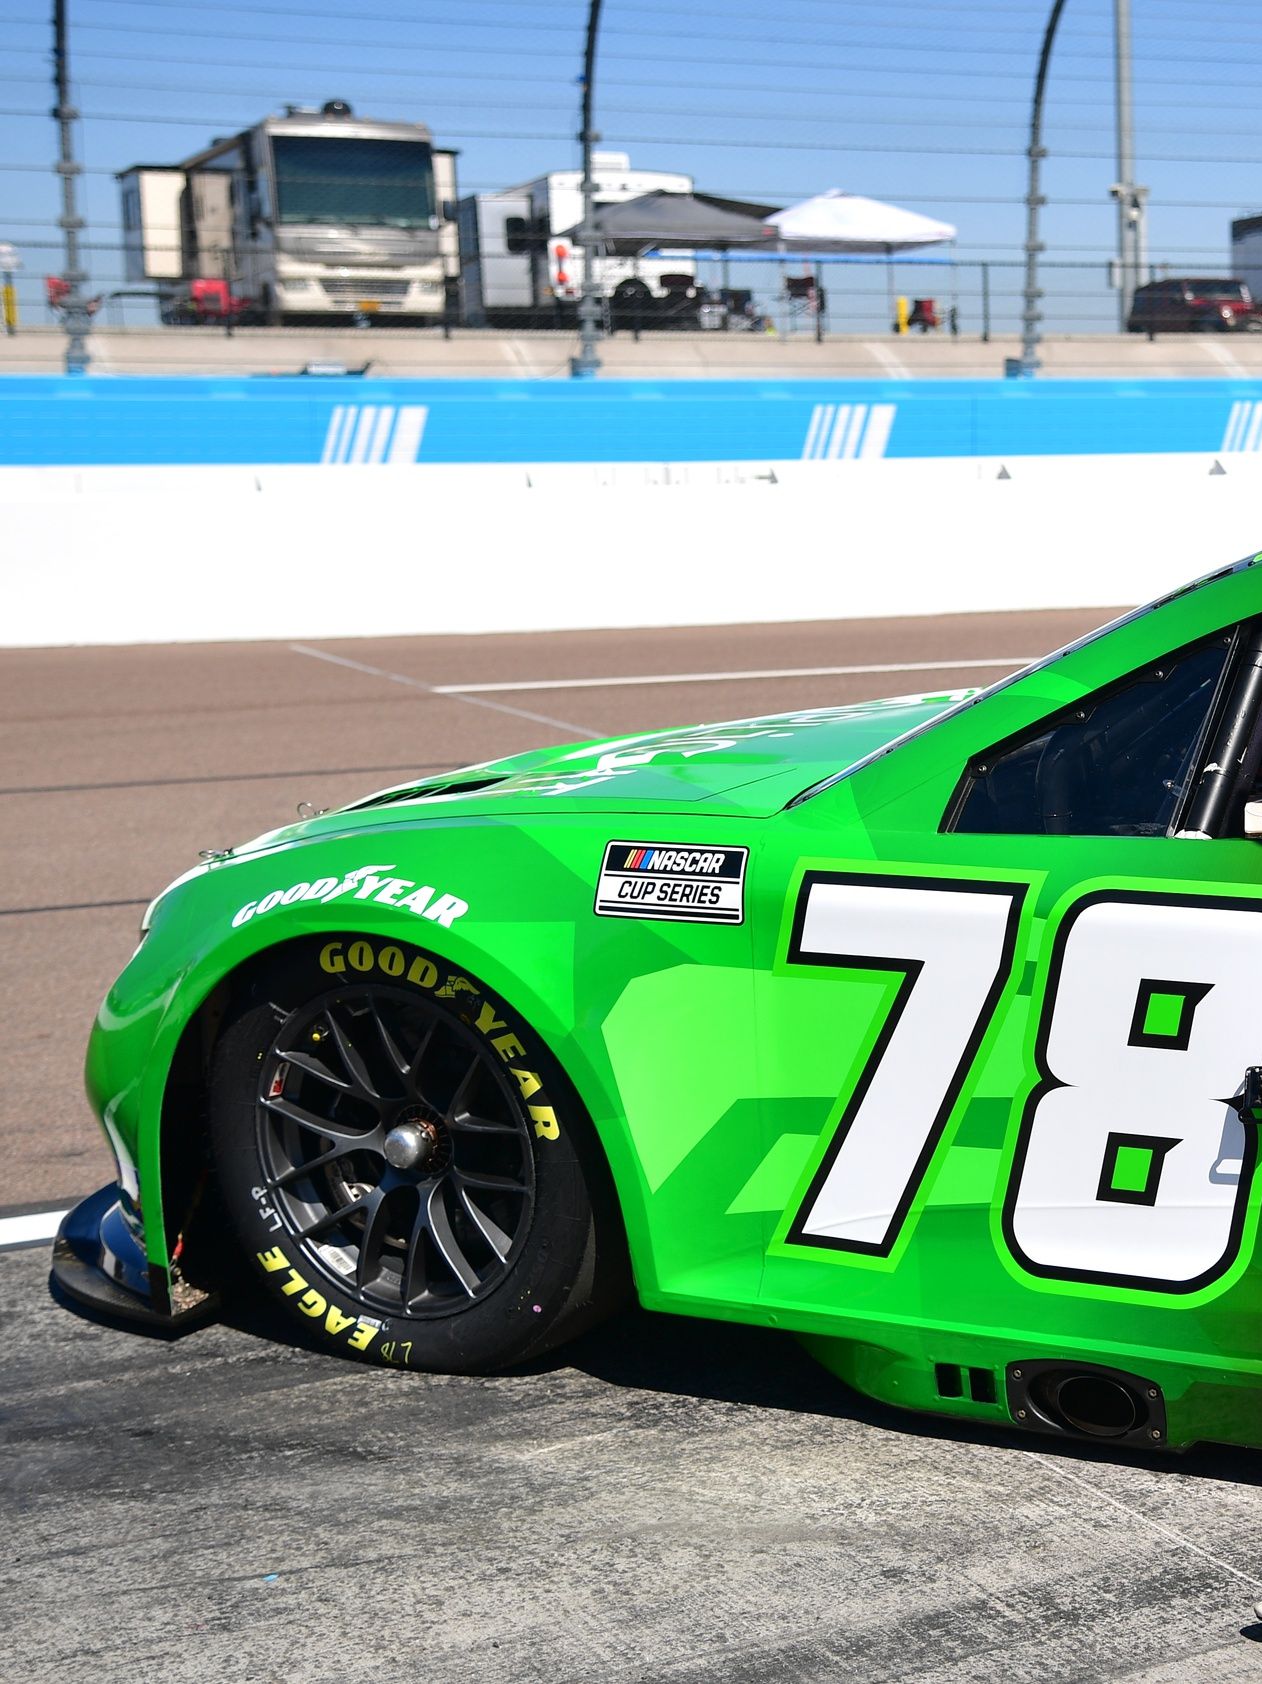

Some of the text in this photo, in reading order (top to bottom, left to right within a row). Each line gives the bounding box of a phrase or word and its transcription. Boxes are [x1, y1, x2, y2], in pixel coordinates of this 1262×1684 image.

[647, 850, 726, 874] NASCAR
[617, 880, 722, 905] CUP SERIES
[256, 1246, 380, 1352] EAGLE
